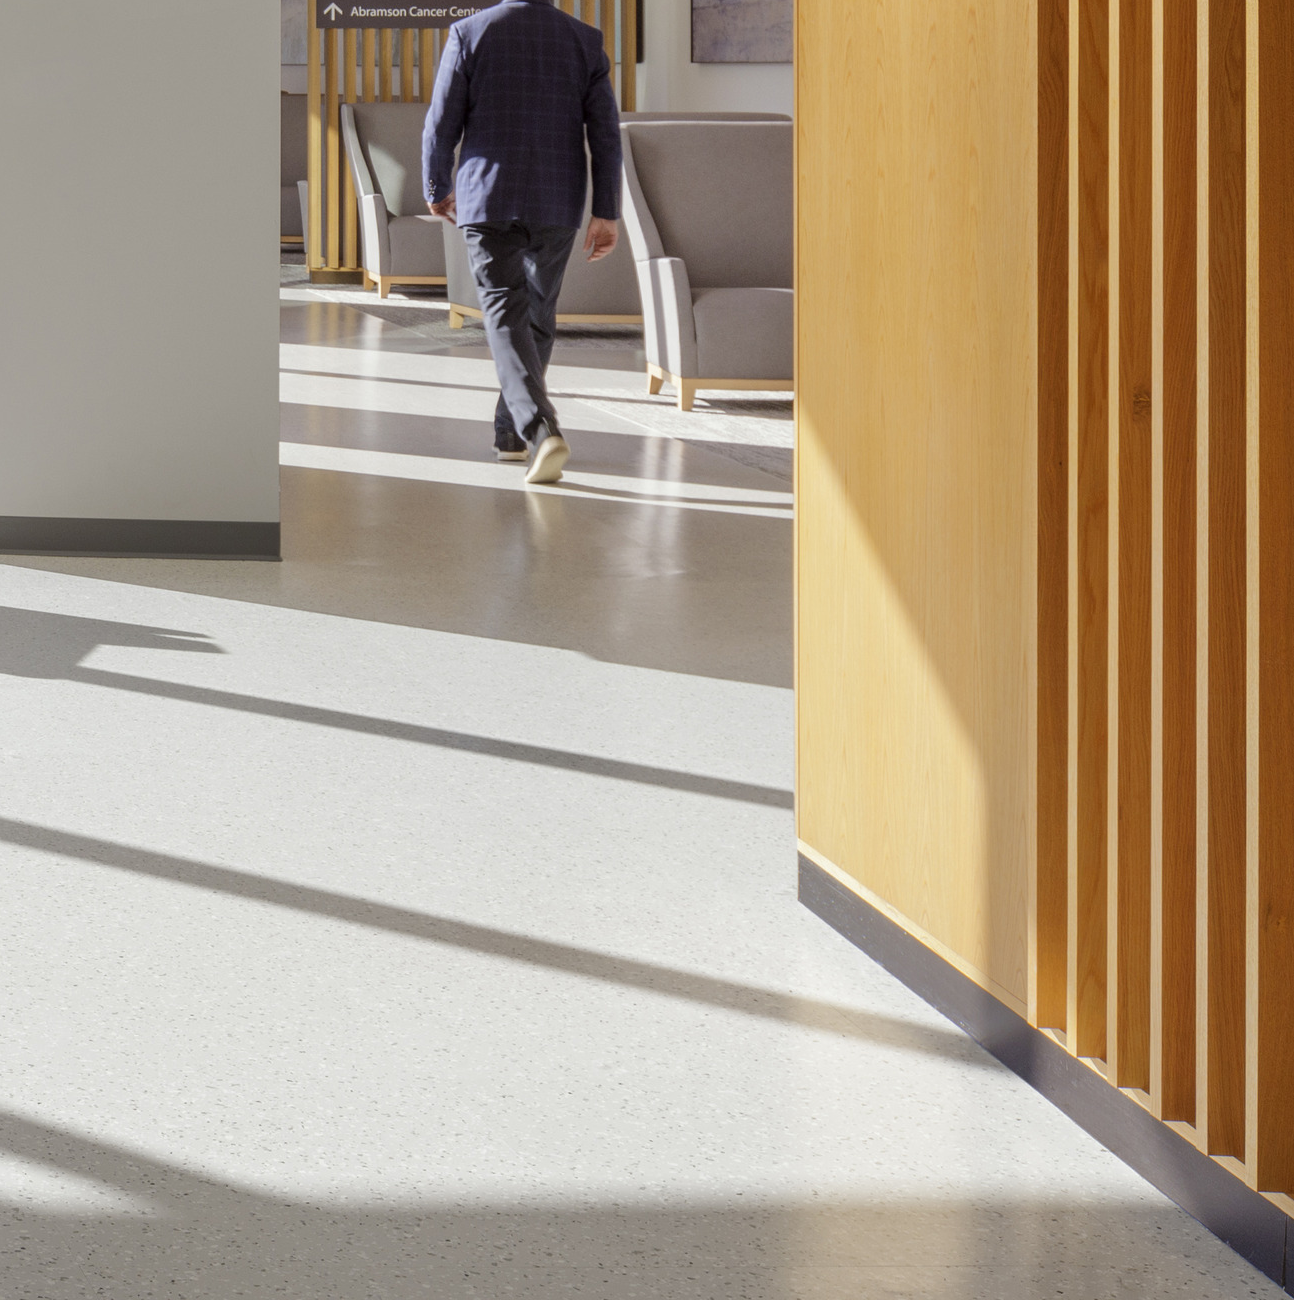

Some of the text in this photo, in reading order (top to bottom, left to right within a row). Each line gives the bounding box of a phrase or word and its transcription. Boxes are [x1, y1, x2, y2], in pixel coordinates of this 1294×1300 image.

[350, 6, 484, 17] Abramson Cancer Cente
